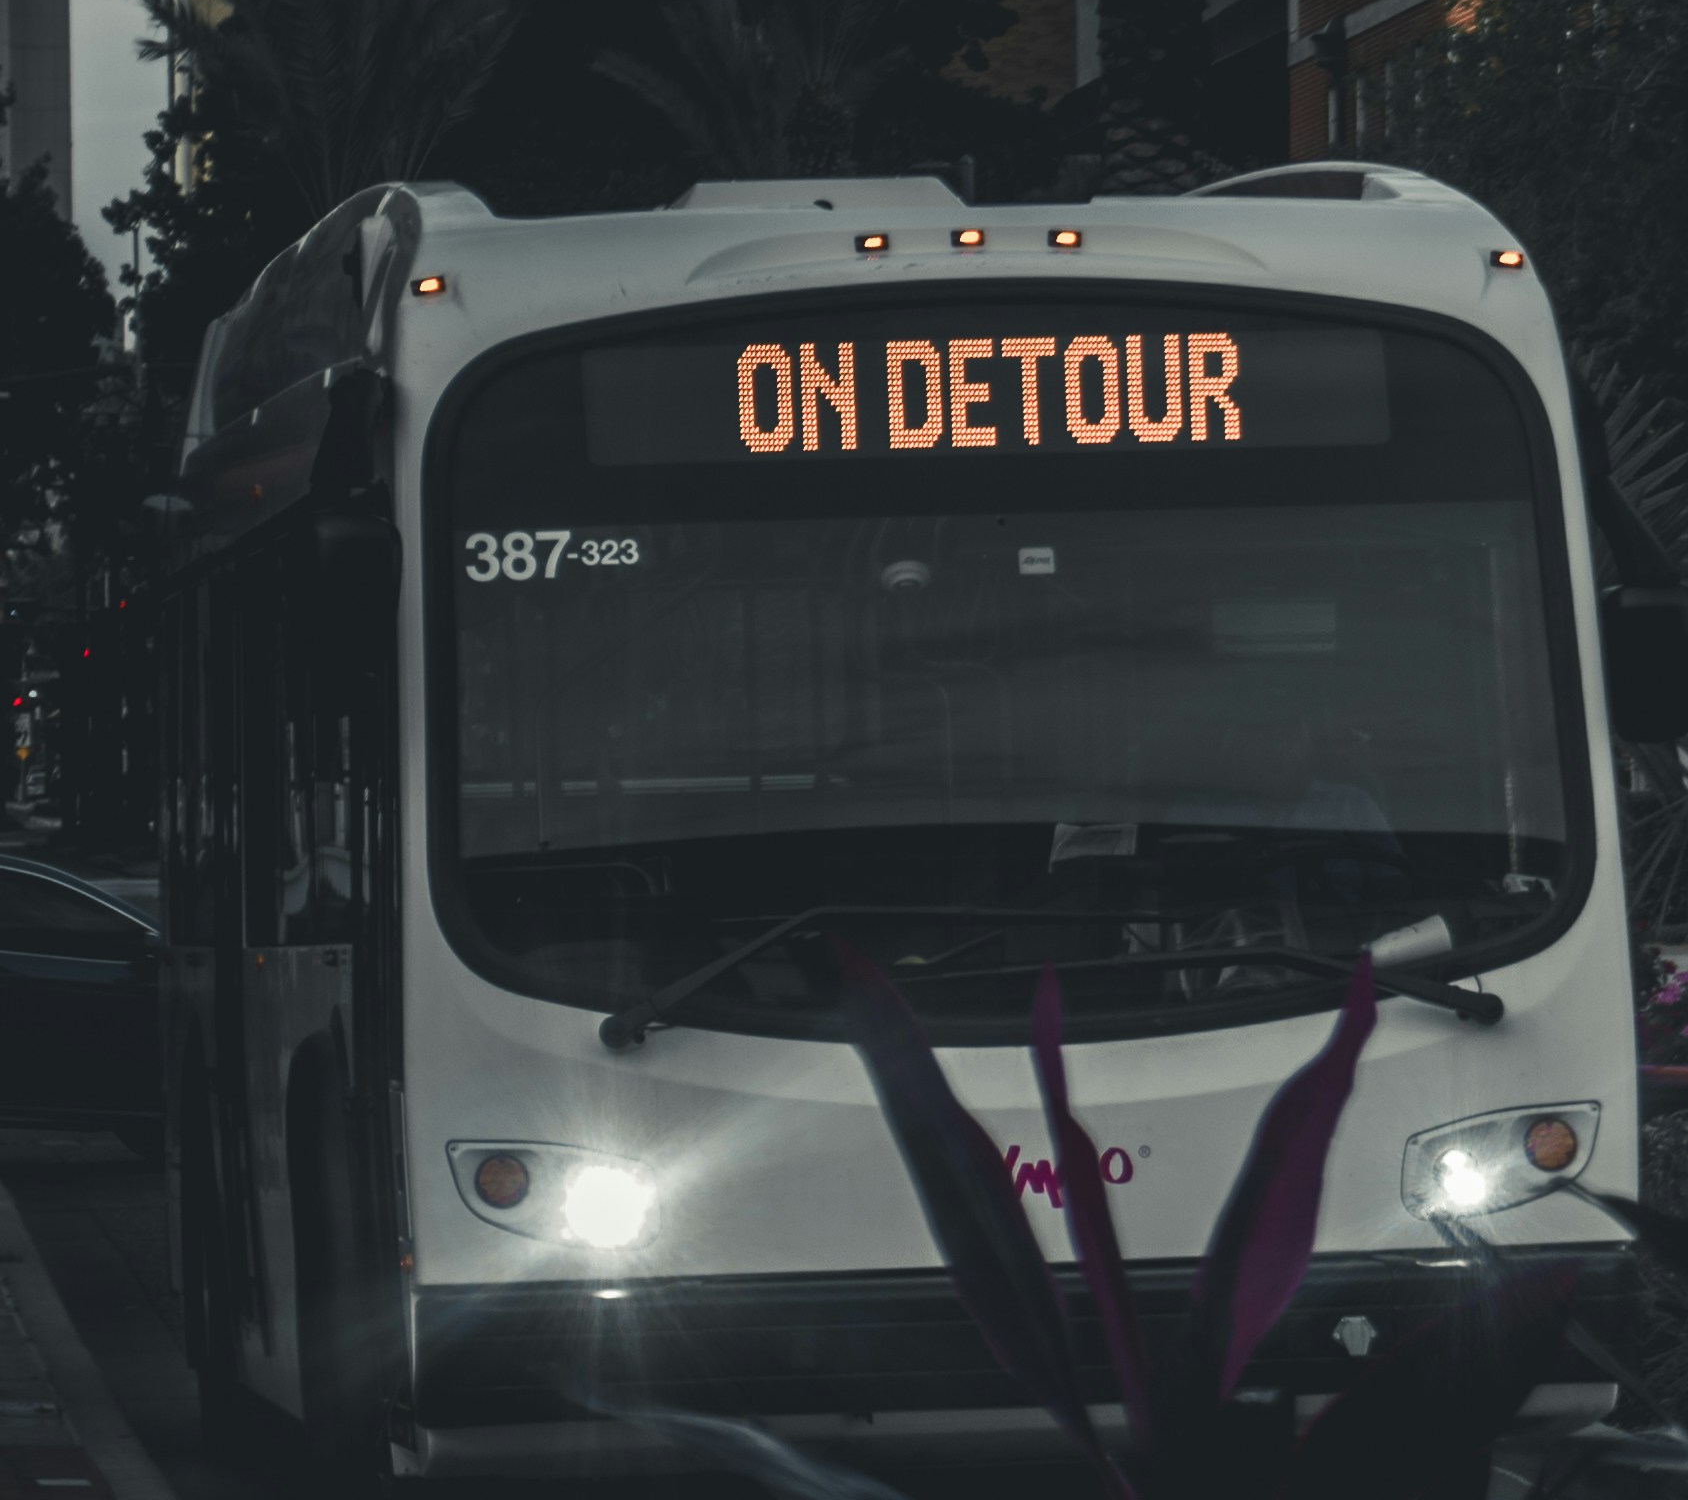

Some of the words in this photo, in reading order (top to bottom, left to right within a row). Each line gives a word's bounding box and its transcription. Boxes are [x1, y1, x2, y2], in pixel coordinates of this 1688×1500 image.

[738, 342, 858, 453] ON
[887, 333, 1241, 450] DETOUR
[465, 530, 640, 582] 387-323
